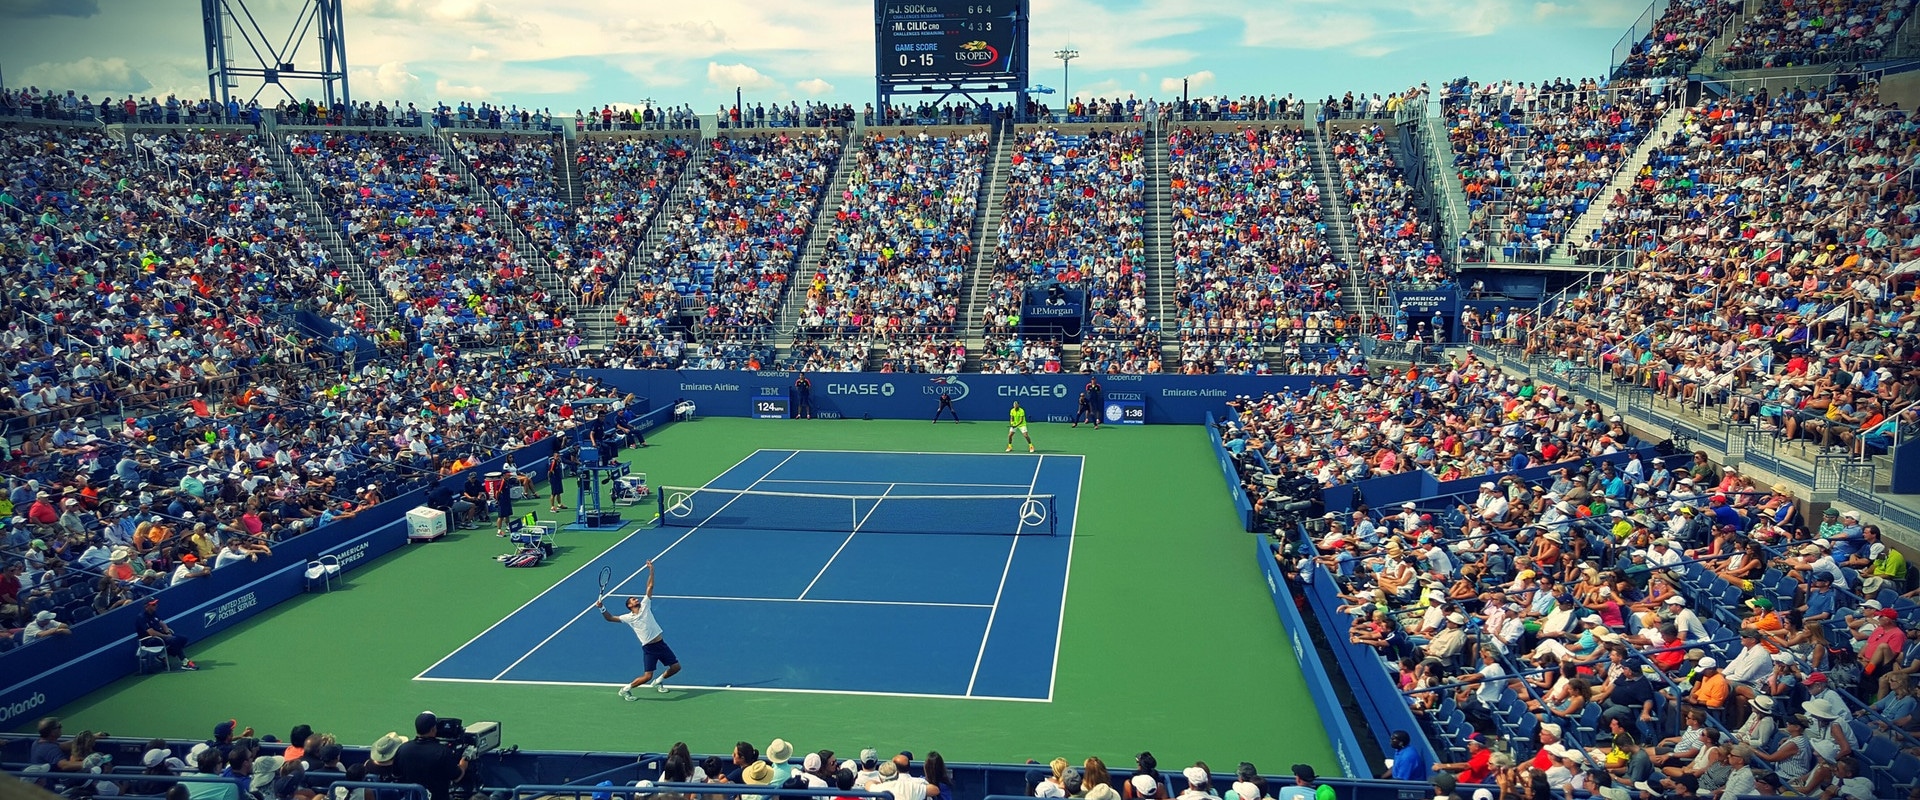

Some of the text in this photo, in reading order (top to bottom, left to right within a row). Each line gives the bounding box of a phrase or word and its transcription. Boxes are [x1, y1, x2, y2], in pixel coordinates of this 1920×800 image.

[894, 5, 902, 14] J.
[904, 4, 926, 13] SOCK
[968, 4, 992, 14] 6 6 4
[896, 22, 906, 31] M.
[906, 22, 928, 30] CILIC
[968, 22, 992, 31] 4 3 3
[895, 44, 914, 52] GAME
[900, 54, 908, 66] 0
[919, 54, 934, 66] 15
[955, 52, 992, 60] US OPEN
[680, 383, 740, 391] Emirates Airline
[760, 387, 779, 396] IBM
[827, 383, 879, 395] CHASE
[922, 385, 962, 394] US OPEN
[998, 385, 1050, 397] CHASE
[1162, 388, 1228, 396] Emirates Airline
[1108, 392, 1142, 400] CITIZEN
[337, 542, 369, 560] AMERICAN
[339, 551, 365, 567] XPRESS
[218, 592, 254, 614] UNITED STATES
[218, 598, 257, 621] POSTAL SERVICE
[0, 691, 46, 722] Orlando
